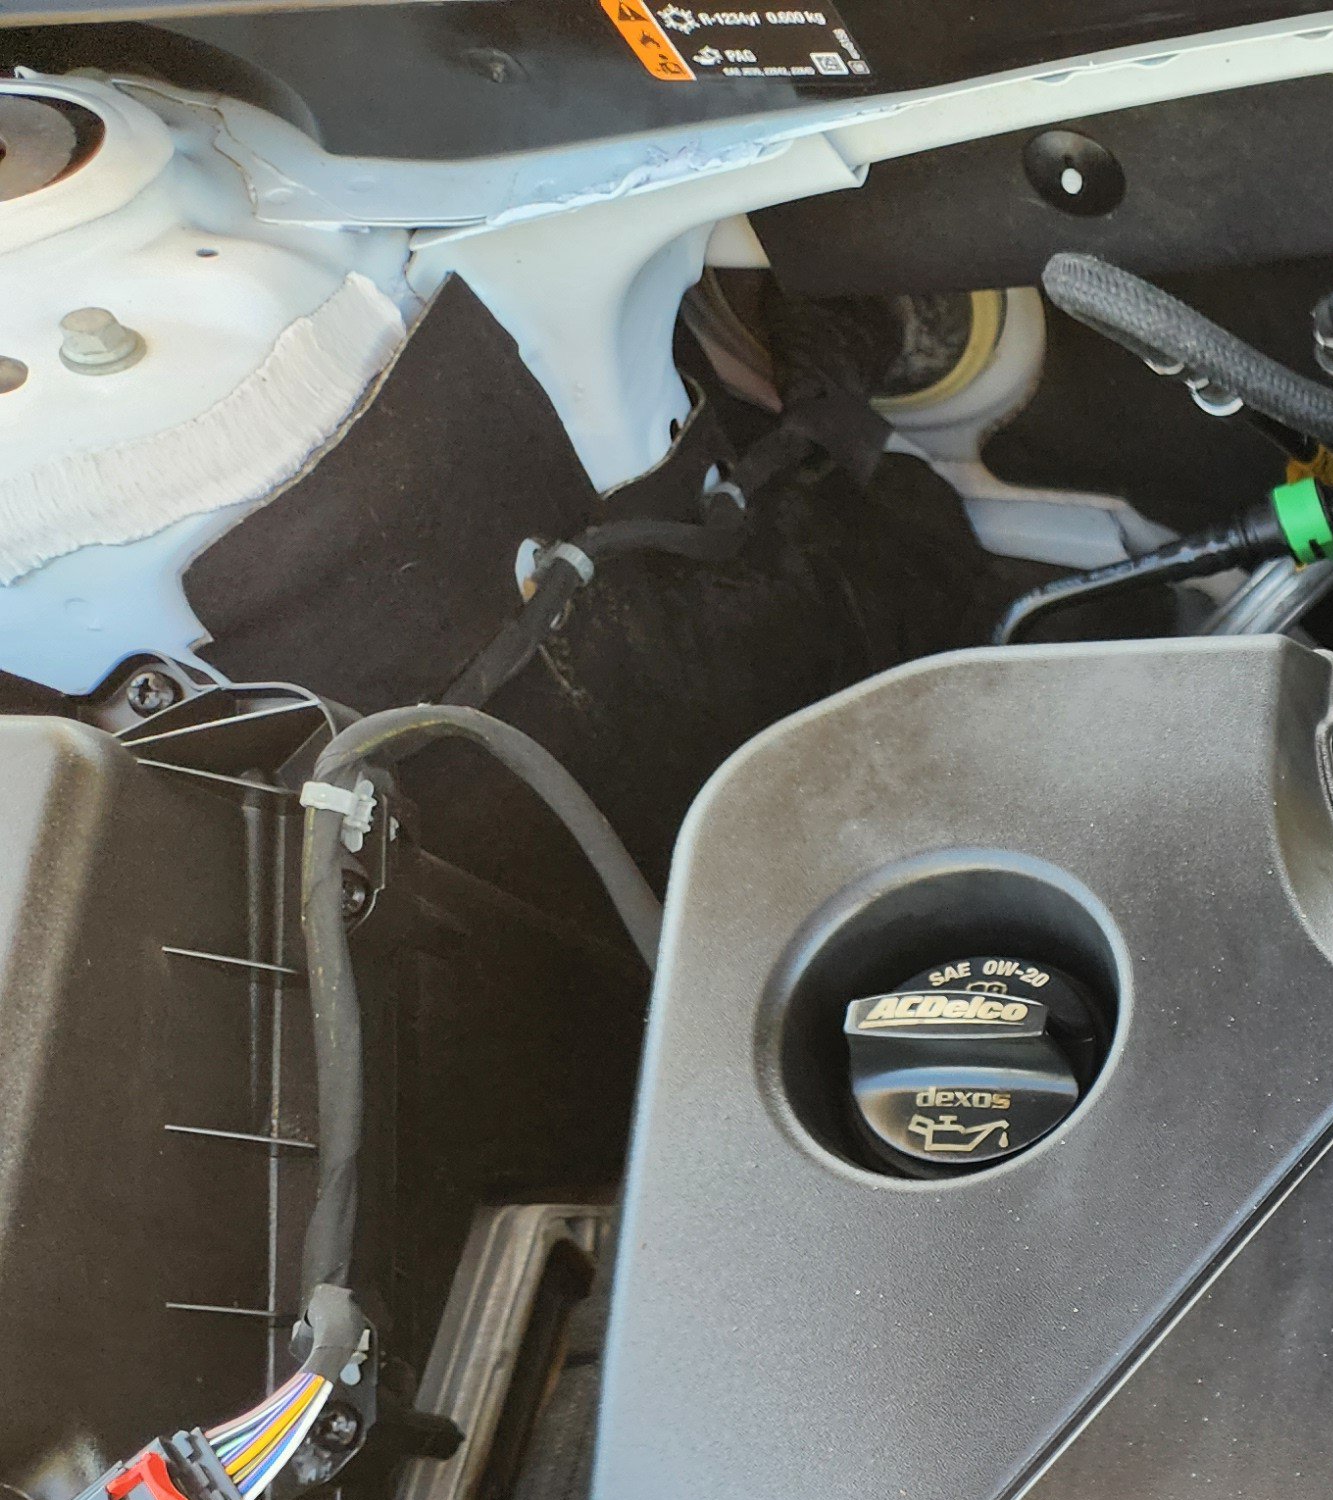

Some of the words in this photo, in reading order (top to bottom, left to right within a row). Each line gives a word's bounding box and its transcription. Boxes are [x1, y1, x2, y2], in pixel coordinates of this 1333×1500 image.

[928, 962, 972, 988] SAE
[982, 959, 1050, 988] 0W-20
[866, 994, 1030, 1022] ACDelco
[915, 1086, 1012, 1110] dexos
